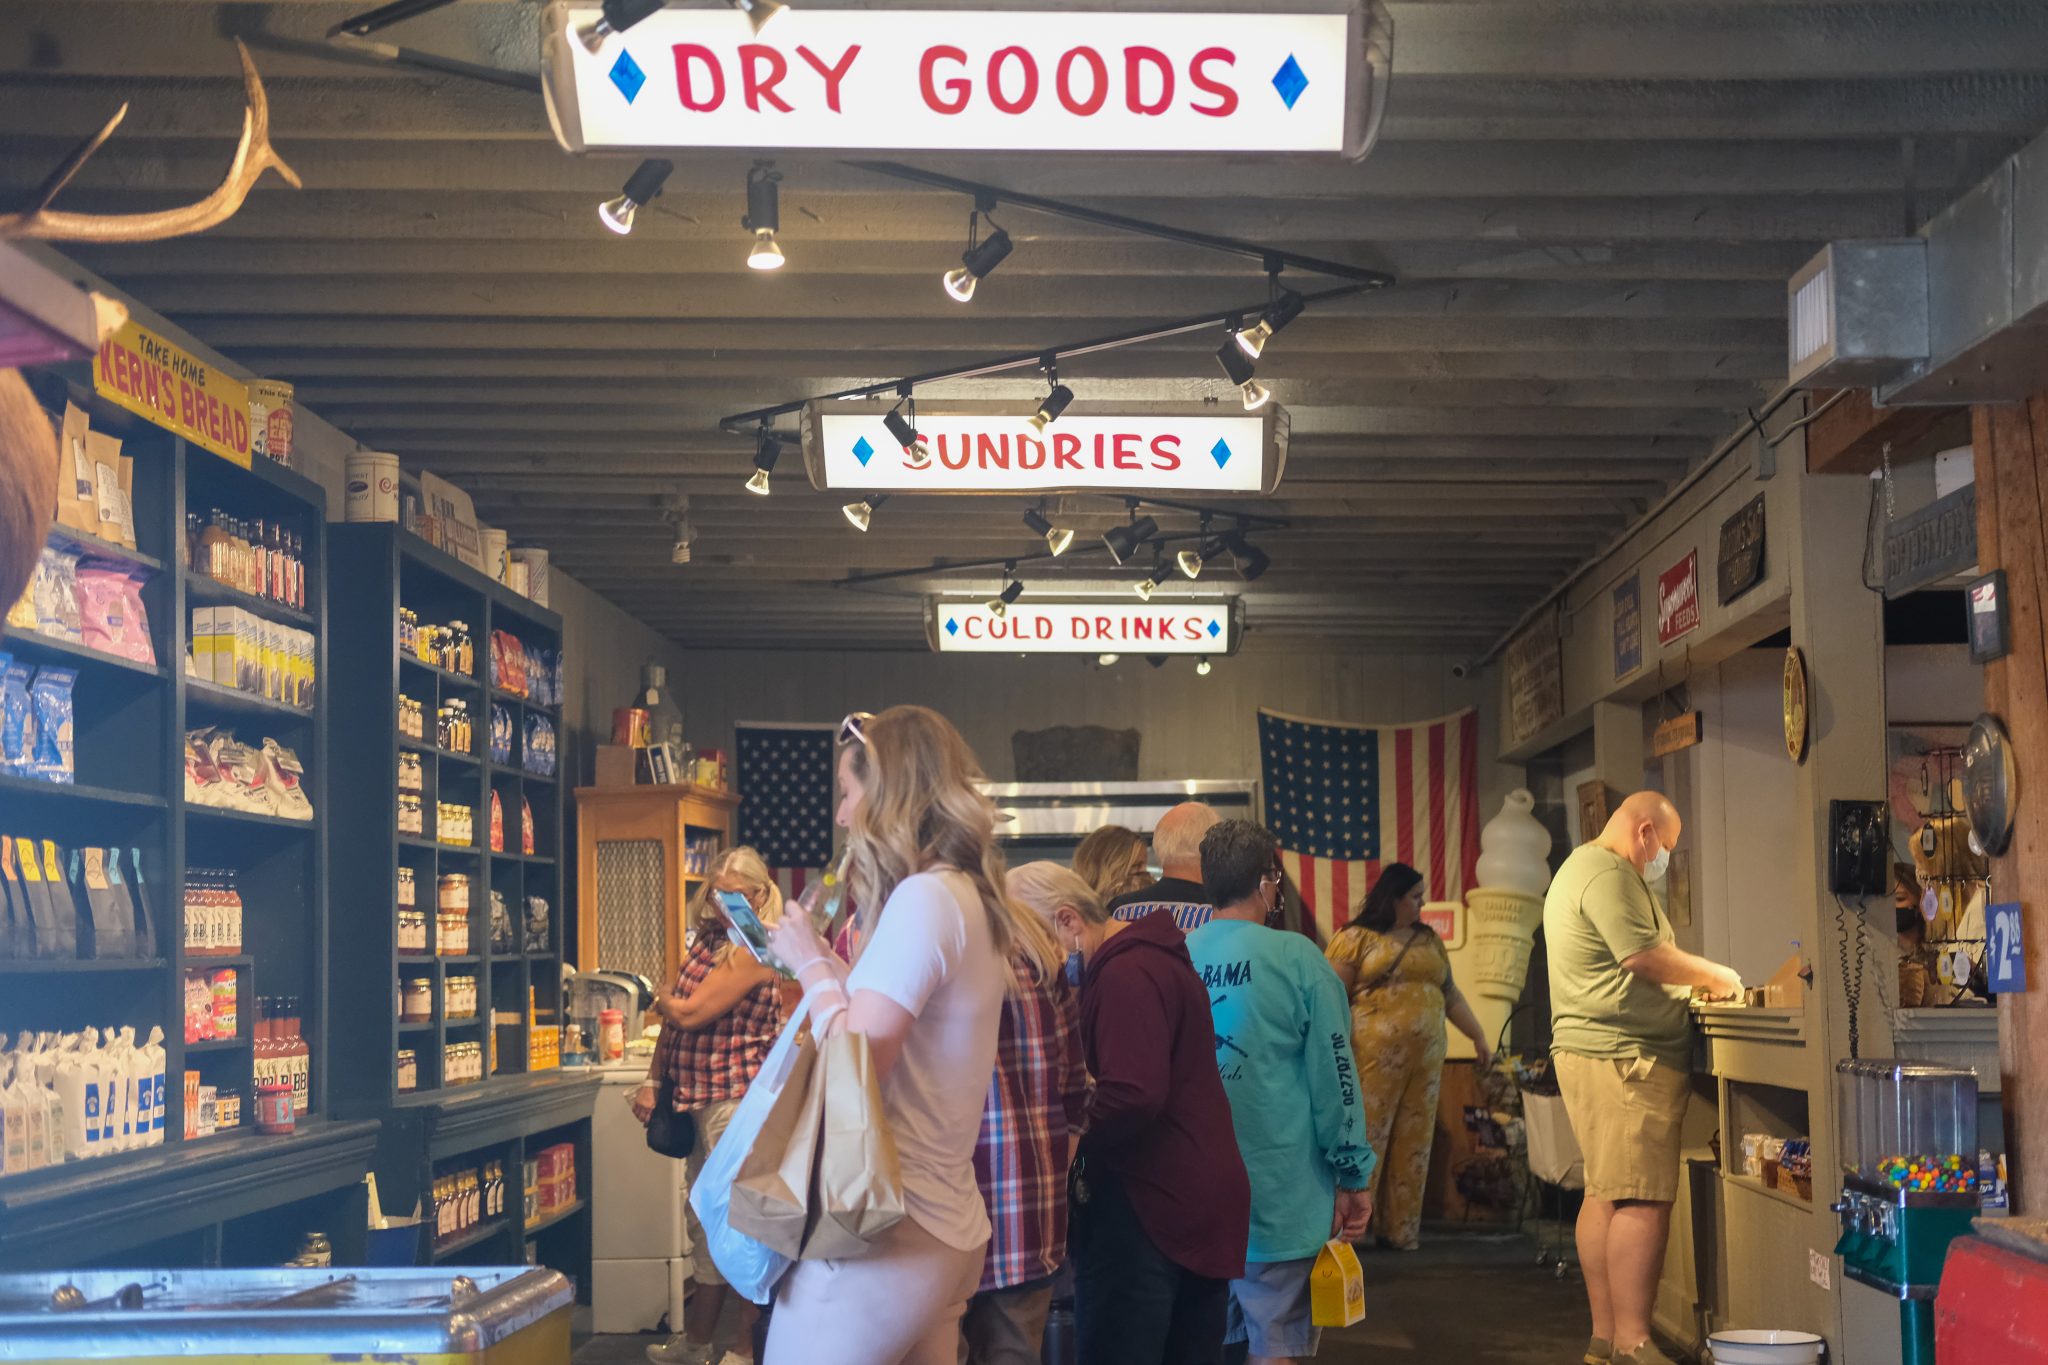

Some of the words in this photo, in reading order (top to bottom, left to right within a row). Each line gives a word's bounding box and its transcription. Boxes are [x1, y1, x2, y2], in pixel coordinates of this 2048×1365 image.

[671, 43, 862, 114] DRY
[918, 43, 1240, 117] GOODS
[138, 334, 169, 367] TAKE
[172, 352, 205, 387] HOME
[100, 338, 176, 419] KERN'S
[180, 379, 248, 454] BREAD
[902, 433, 1181, 470] SUNDRIES
[964, 616, 1054, 640] COLD
[1070, 617, 1203, 641] DRINKS
[1675, 605, 1695, 631] FEEDS
